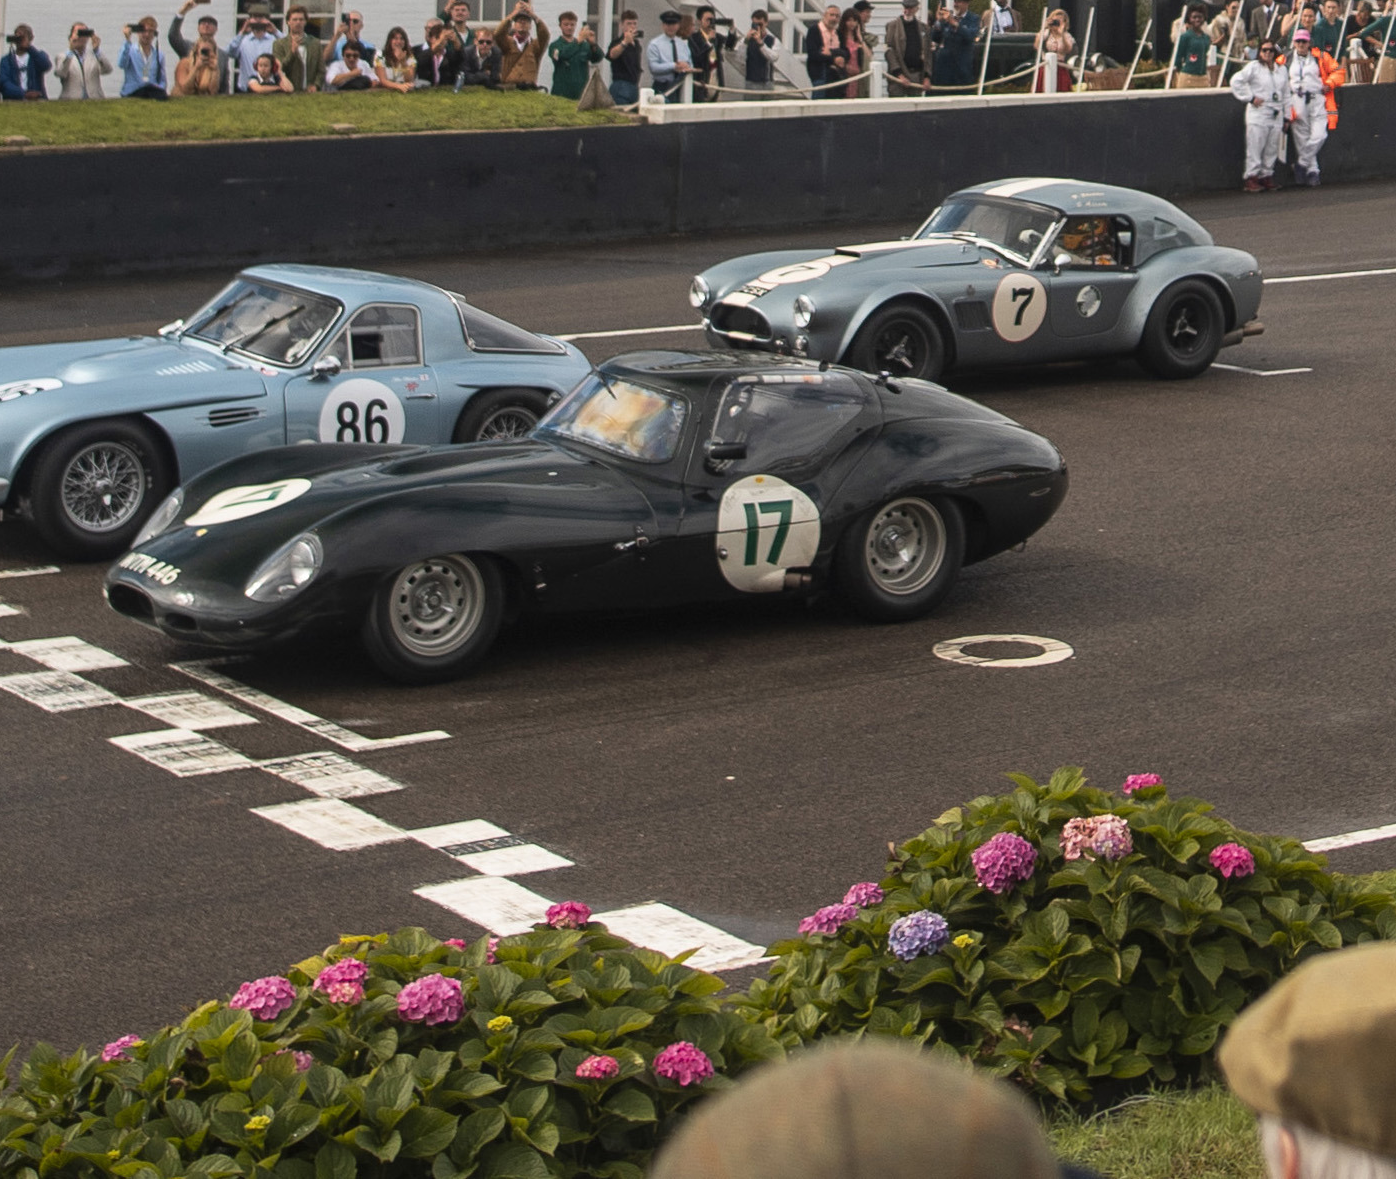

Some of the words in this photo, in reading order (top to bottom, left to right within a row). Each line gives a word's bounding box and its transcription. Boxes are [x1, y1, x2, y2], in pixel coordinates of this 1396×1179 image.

[1012, 287, 1035, 326] 7
[336, 398, 390, 443] 86
[743, 499, 793, 566] 17
[146, 561, 182, 585] 446
